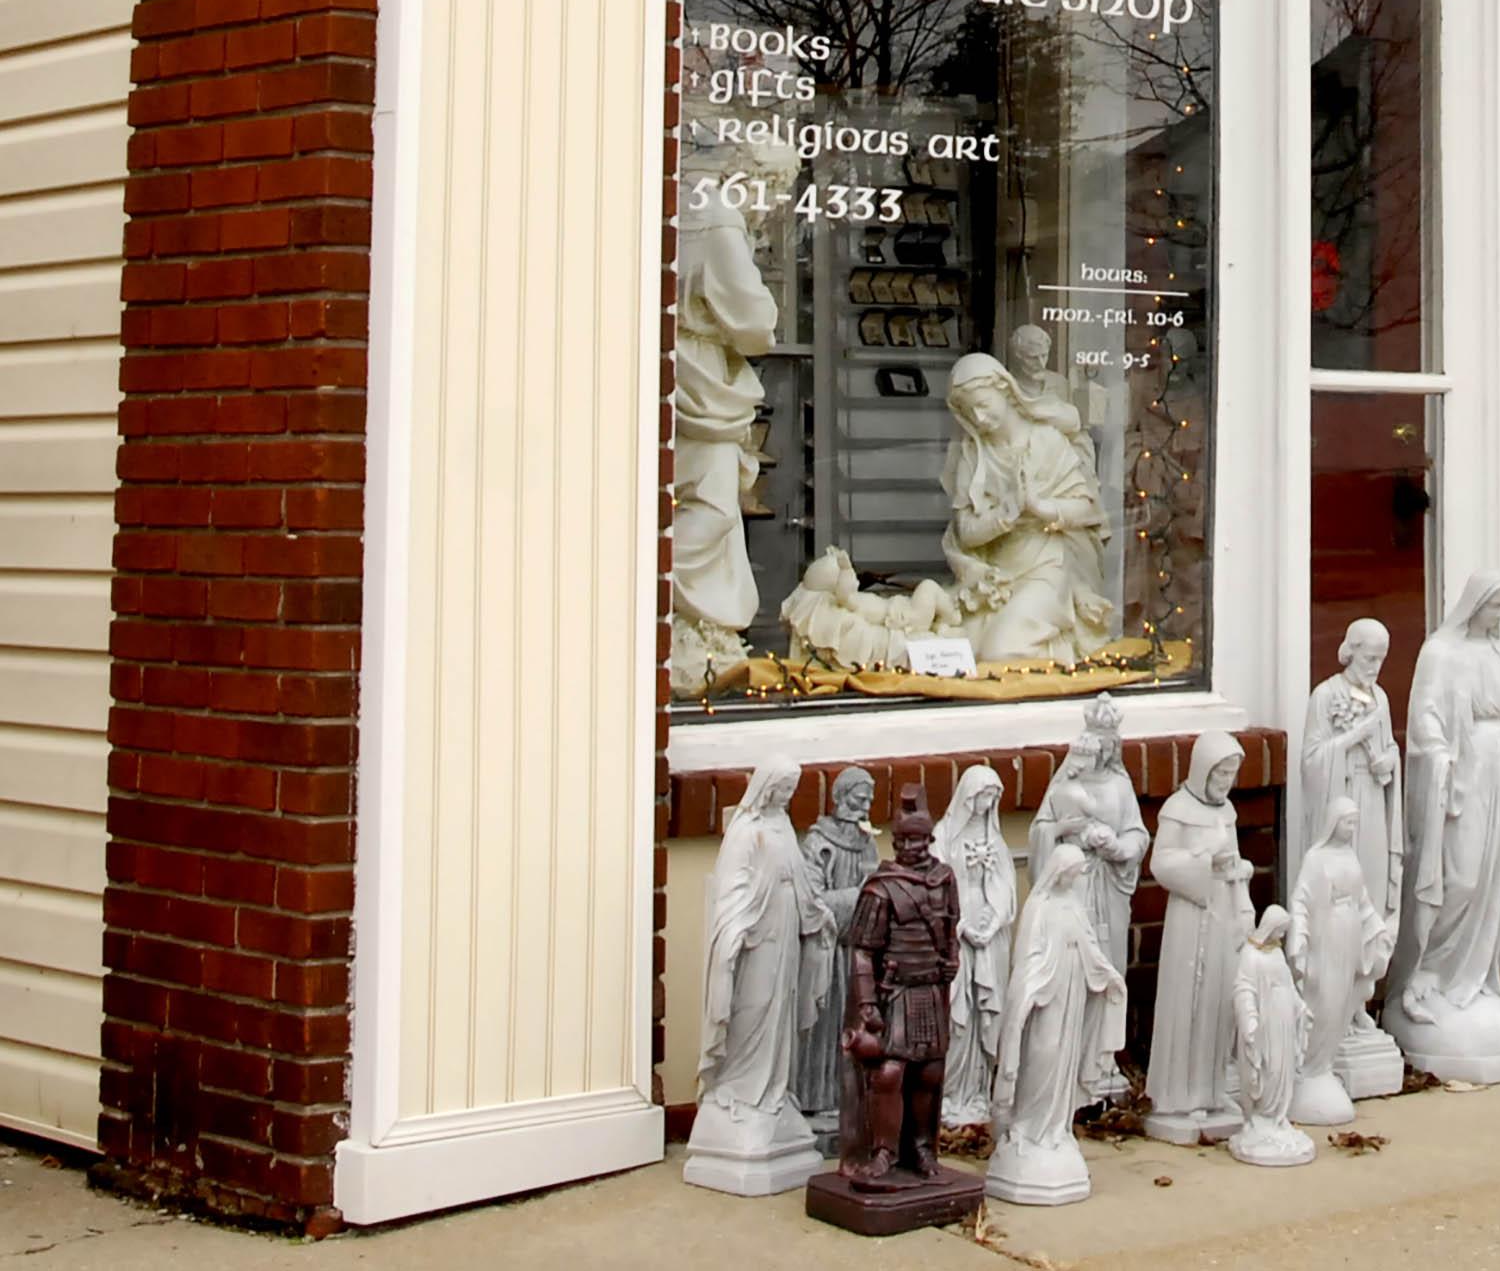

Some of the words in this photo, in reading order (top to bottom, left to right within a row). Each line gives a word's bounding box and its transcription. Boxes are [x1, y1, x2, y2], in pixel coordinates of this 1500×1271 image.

[708, 65, 817, 107] gifts
[688, 172, 904, 223] 561-4333
[1146, 311, 1185, 327] 10-6
[1075, 348, 1114, 366] sat.
[1122, 353, 1151, 369] 9-5
